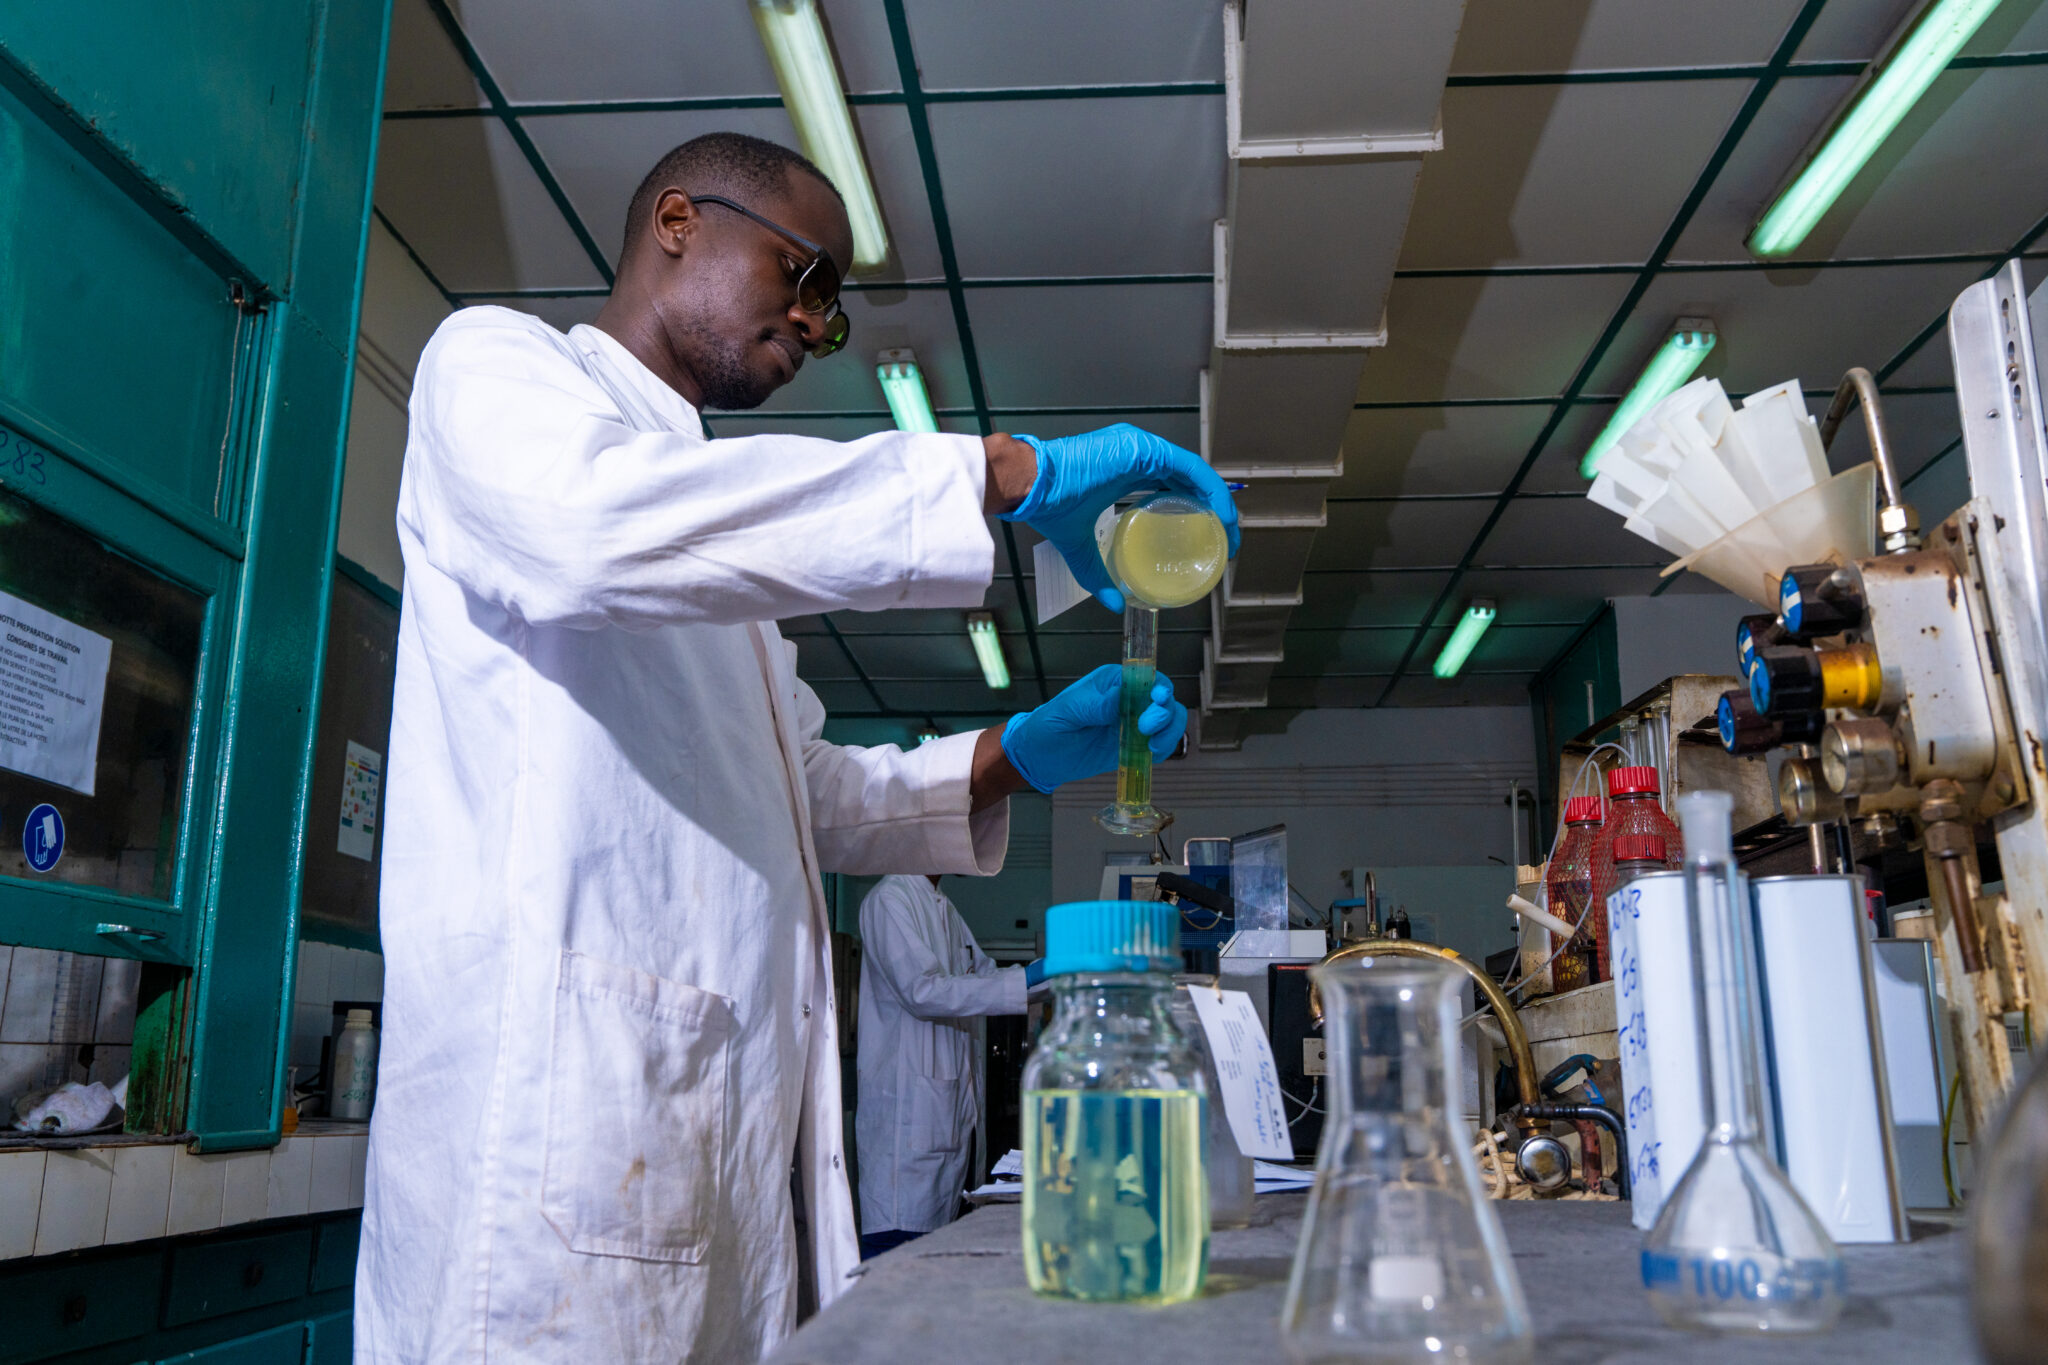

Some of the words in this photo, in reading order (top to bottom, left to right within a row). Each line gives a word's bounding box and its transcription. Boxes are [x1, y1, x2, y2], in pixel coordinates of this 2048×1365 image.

[0, 614, 16, 627] OTTE
[55, 637, 81, 654] SOLUTION
[7, 633, 37, 652] CONSIGNES
[38, 646, 46, 655] DE
